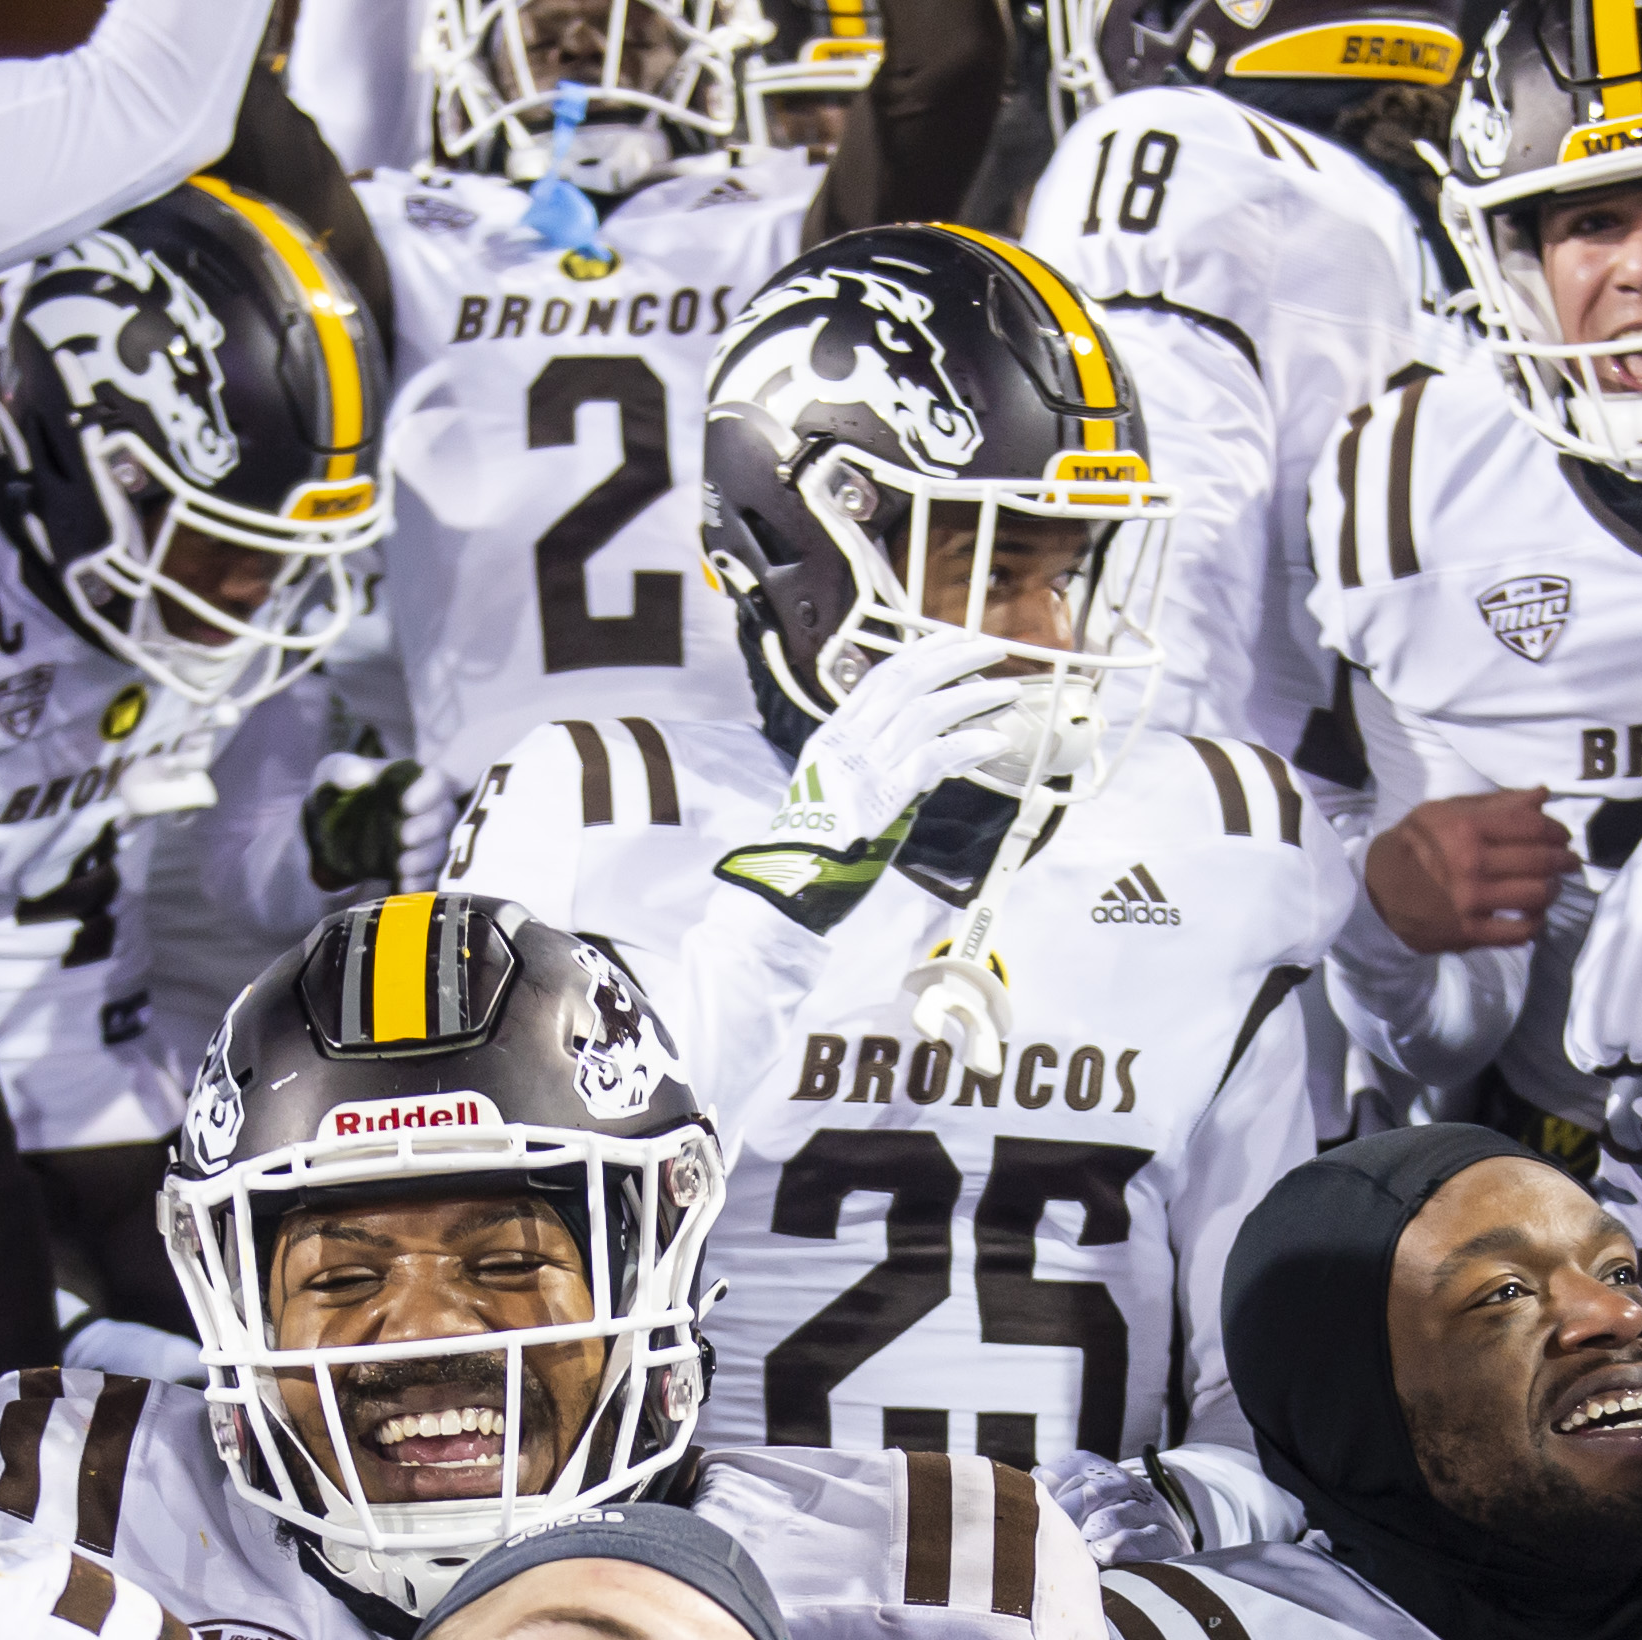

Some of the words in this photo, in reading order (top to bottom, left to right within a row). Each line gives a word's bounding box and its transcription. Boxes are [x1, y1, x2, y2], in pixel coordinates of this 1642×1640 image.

[1081, 130, 1179, 237] 18
[449, 286, 734, 345] BRONCOS
[527, 355, 684, 675] 2
[1489, 597, 1570, 631] MAC
[1091, 901, 1181, 926] adidas
[789, 1033, 1142, 1113] BRONCOS
[335, 1100, 479, 1137] Riddell
[764, 1128, 1156, 1464] 25
